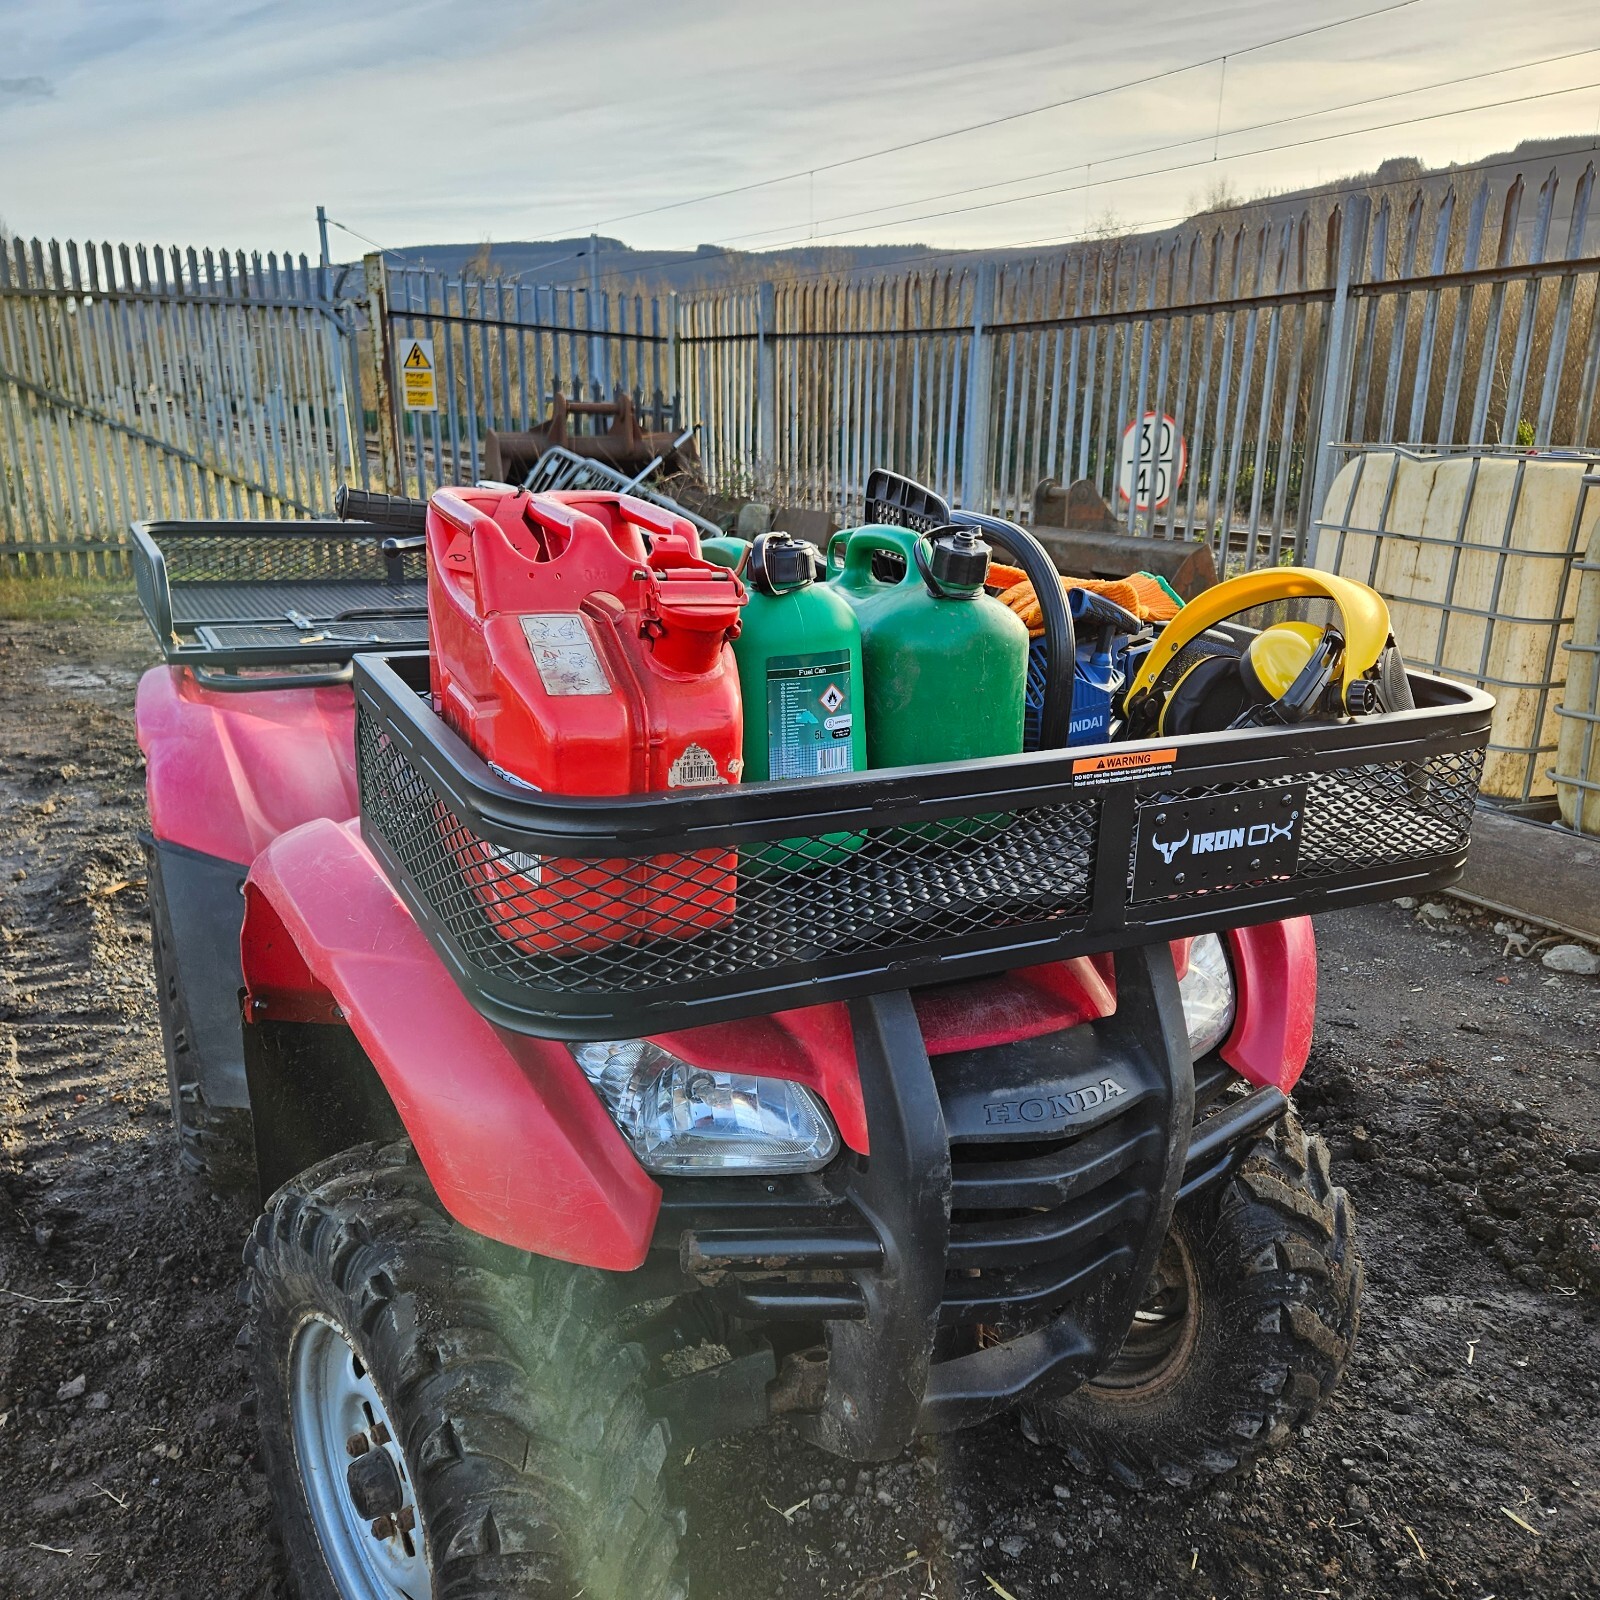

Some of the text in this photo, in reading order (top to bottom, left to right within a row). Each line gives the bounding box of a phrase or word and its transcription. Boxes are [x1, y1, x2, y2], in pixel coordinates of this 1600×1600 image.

[1068, 715, 1103, 734] UNDAI
[815, 730, 825, 740] 5L
[1107, 754, 1151, 768] WARNING
[1191, 820, 1295, 855] IRON OX
[983, 1077, 1128, 1126] HONDA
